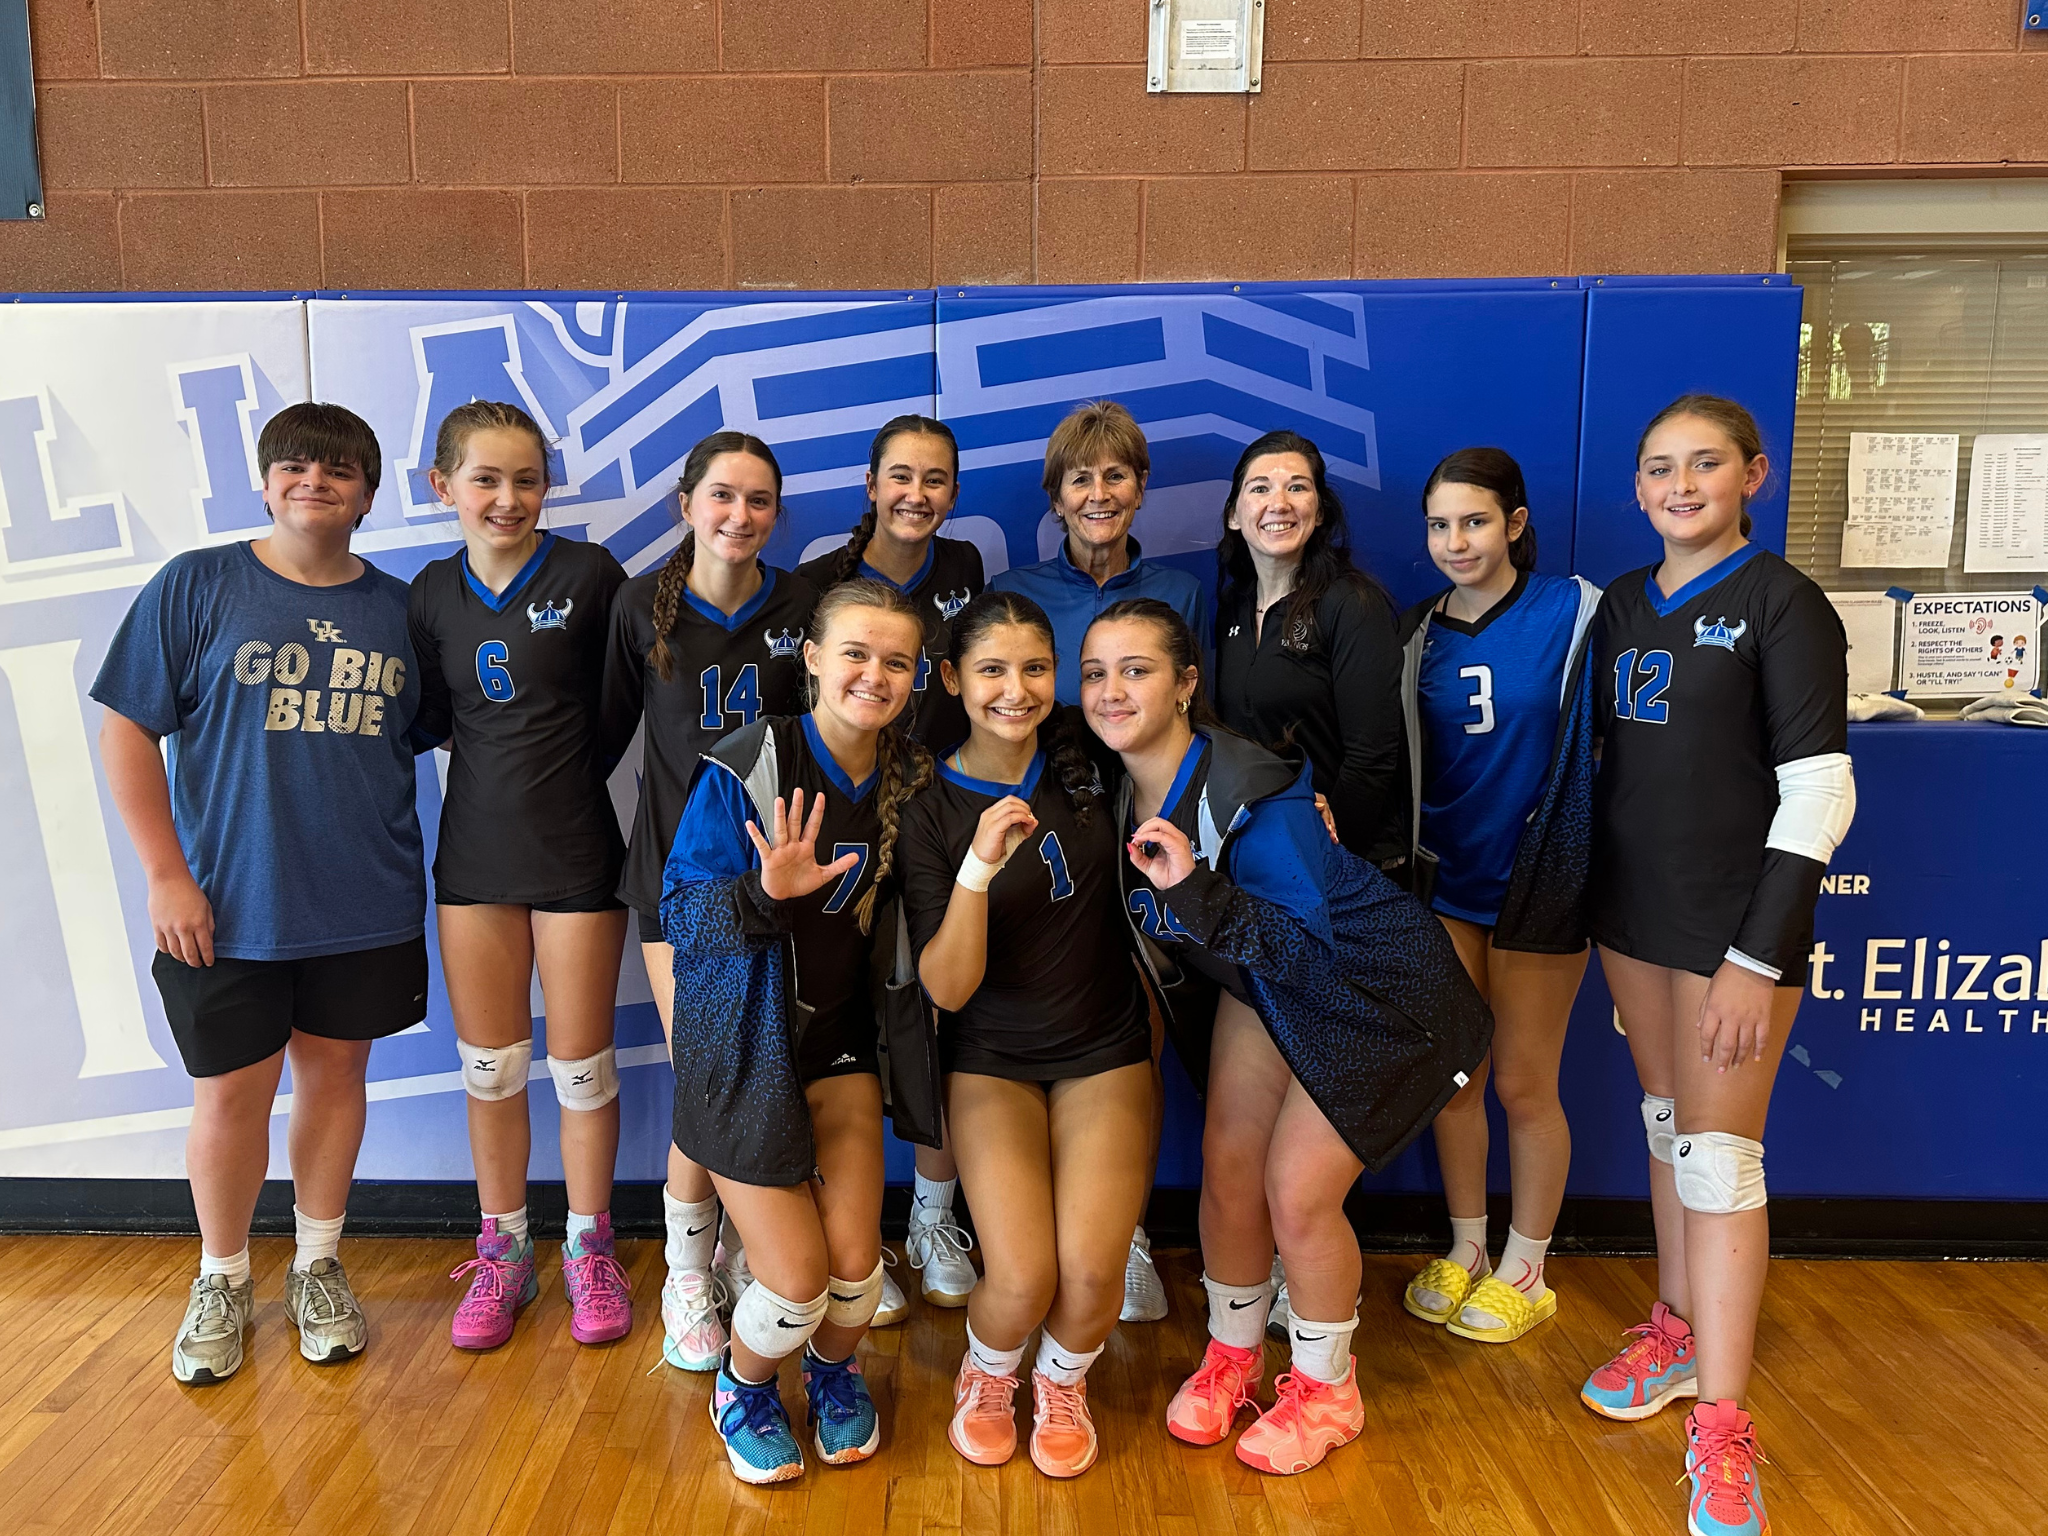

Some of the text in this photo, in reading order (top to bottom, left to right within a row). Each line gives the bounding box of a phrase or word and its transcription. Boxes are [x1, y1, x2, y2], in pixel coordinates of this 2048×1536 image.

[306, 618, 348, 643] UK
[1914, 600, 2031, 615] EXPECTATIONS
[1918, 621, 1945, 629] FREEZE,
[233, 640, 406, 697] GO BIG
[475, 640, 516, 703] 6
[1918, 640, 1949, 648] RESPECT
[264, 687, 386, 736] BLUE
[700, 664, 763, 730] 14
[1459, 664, 1496, 735] 3
[1614, 648, 1674, 725] 12
[822, 842, 869, 914] 7
[1038, 830, 1074, 902] 1
[1860, 1008, 2048, 1034] HEALTH
